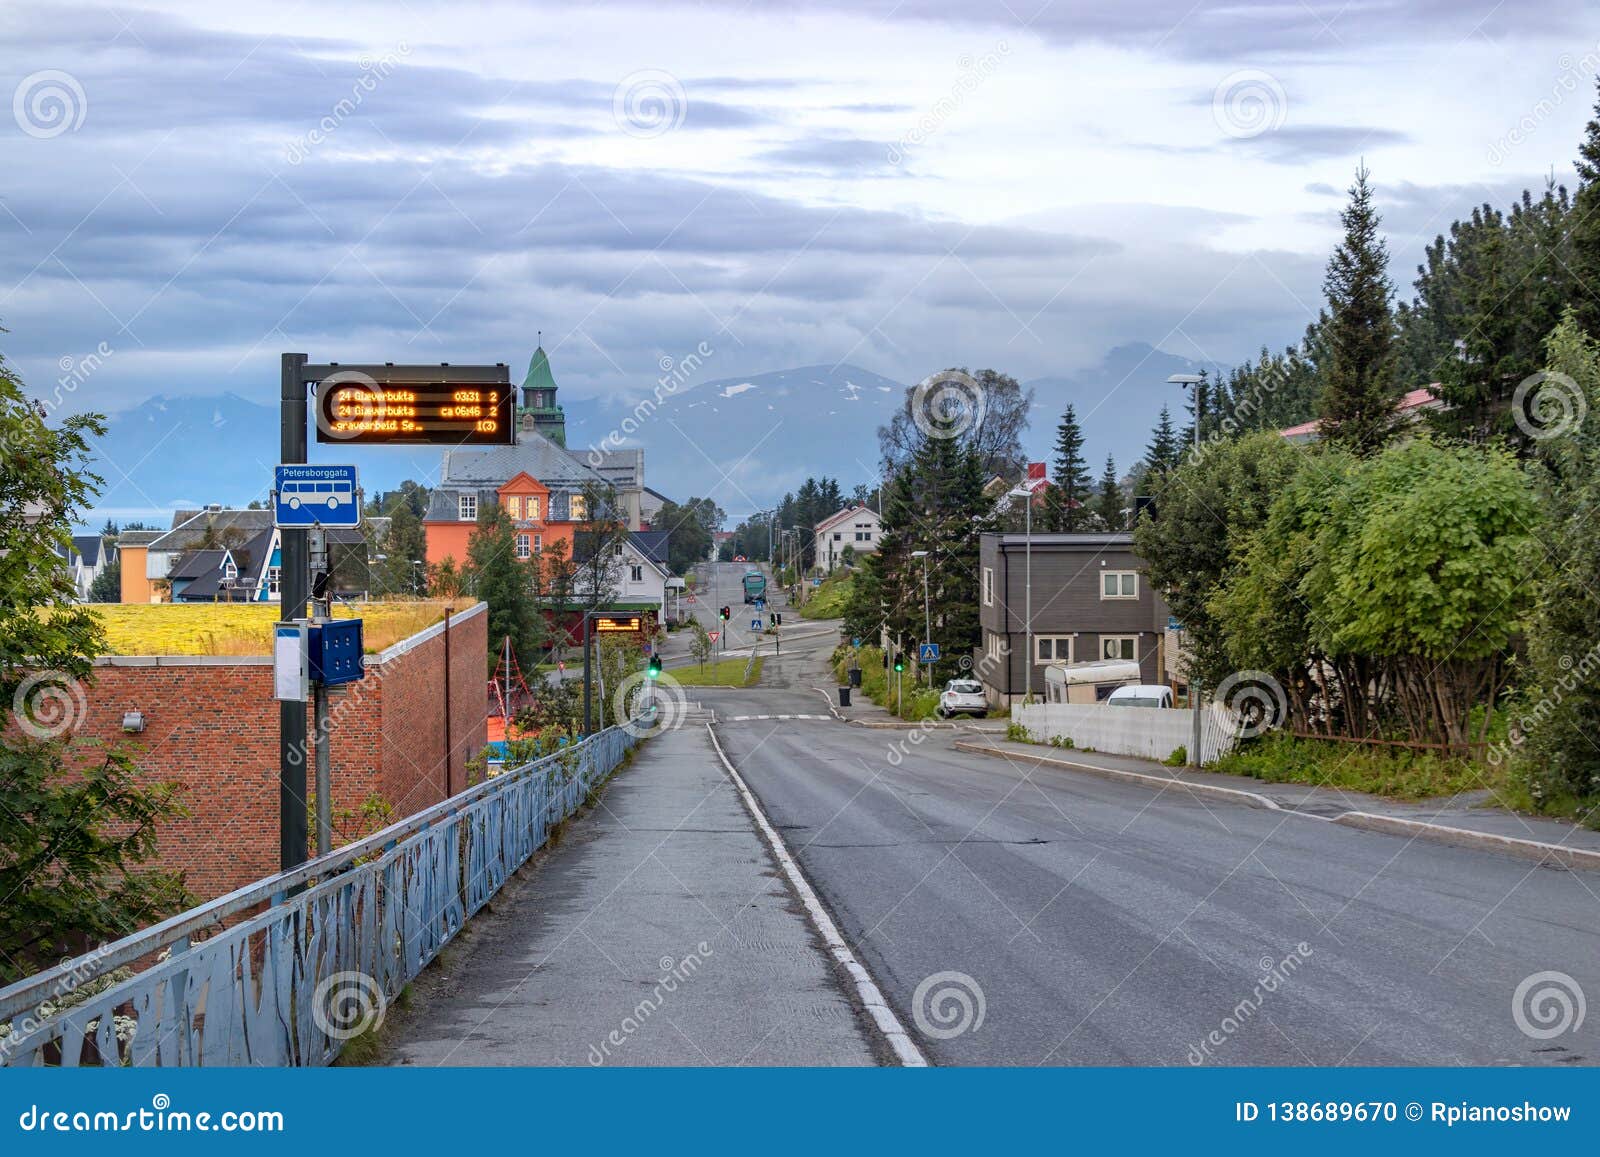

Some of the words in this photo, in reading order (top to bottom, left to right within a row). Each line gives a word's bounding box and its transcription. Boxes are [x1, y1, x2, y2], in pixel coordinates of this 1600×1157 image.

[339, 391, 350, 401] 24
[455, 391, 480, 402] 03:31
[490, 391, 498, 402] 2
[339, 406, 350, 416] 24
[441, 407, 453, 417] ca
[490, 406, 498, 417] 2
[283, 468, 348, 478] Petersborggata
